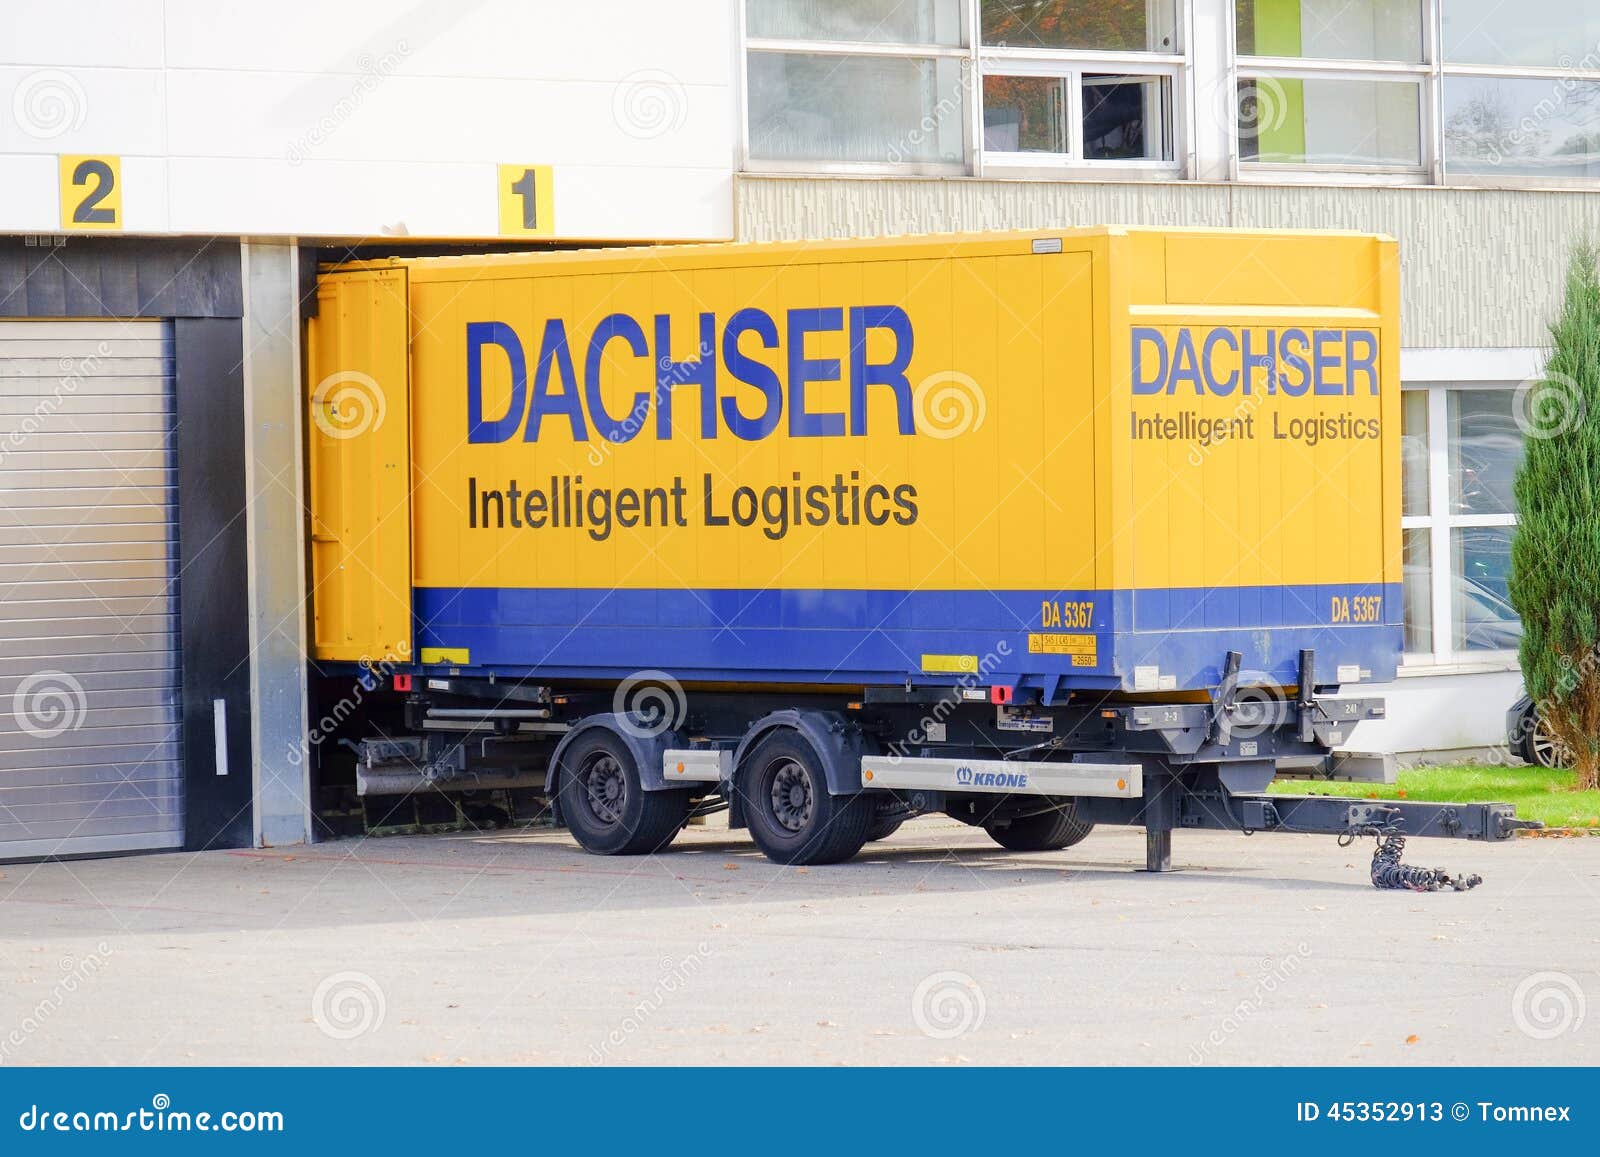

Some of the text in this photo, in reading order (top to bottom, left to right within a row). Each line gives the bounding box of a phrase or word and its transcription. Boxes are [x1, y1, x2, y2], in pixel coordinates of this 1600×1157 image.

[72, 159, 116, 223] 2
[511, 168, 537, 230] 1
[466, 304, 917, 444] DACHSER
[1131, 327, 1379, 397] DACHSER
[1131, 411, 1380, 447] Intelligent Logistics
[468, 470, 919, 542] Intelligent Logistics
[1042, 601, 1094, 628] DA 5367
[1331, 596, 1382, 623] DA 5367
[974, 772, 1028, 788] KRONE
